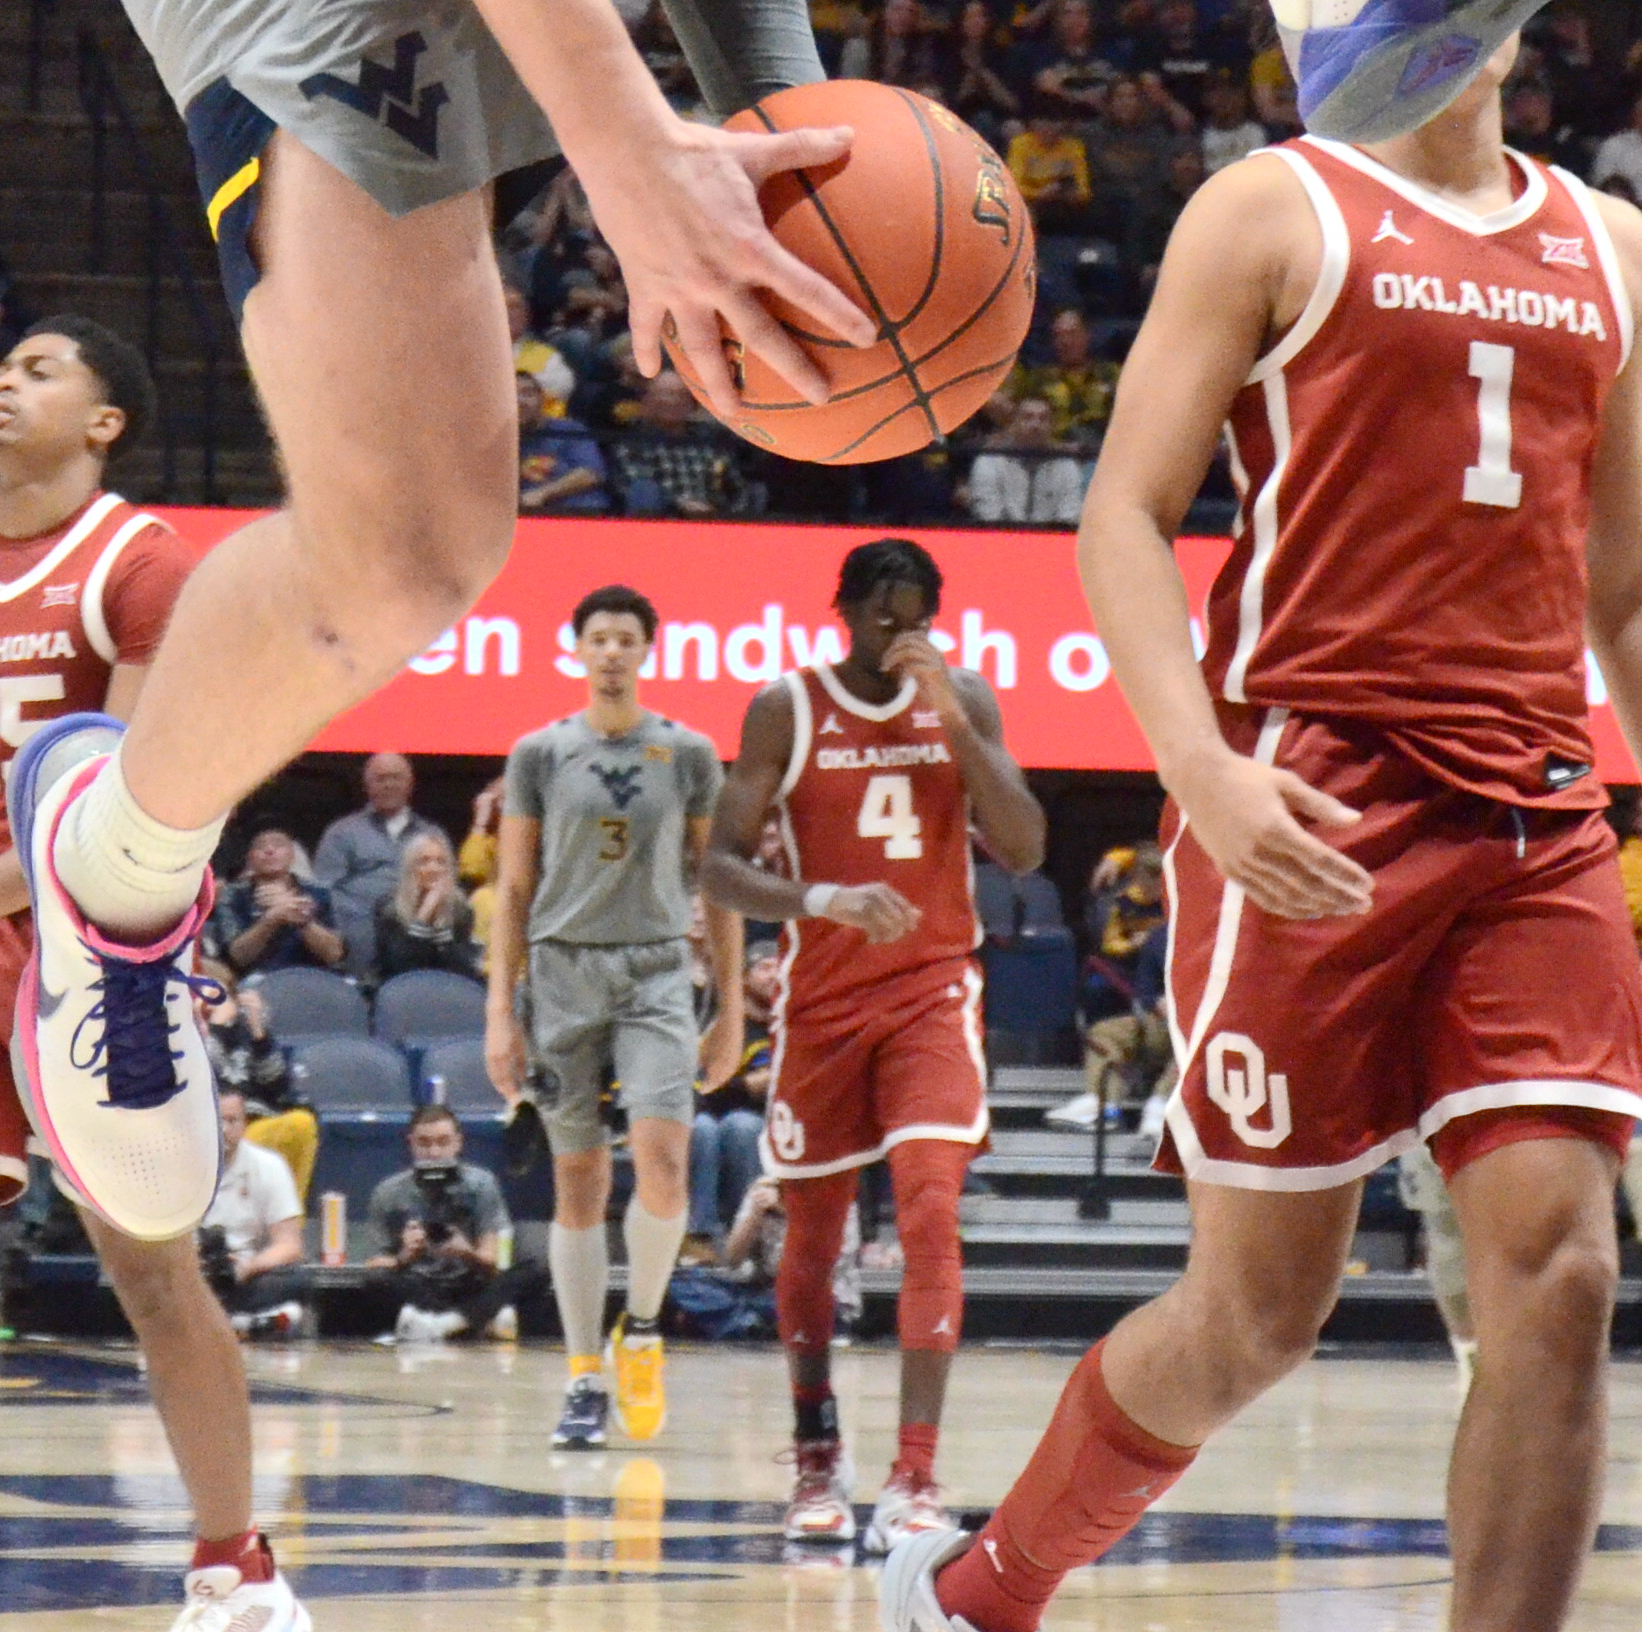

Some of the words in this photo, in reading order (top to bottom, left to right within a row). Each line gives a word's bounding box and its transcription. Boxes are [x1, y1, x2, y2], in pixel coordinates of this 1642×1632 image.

[1372, 272, 1607, 343] OKLAHOMA
[1462, 341, 1522, 509] 1
[816, 743, 952, 770] OKLAHOMA
[598, 816, 630, 862] 3
[857, 774, 923, 860] 4
[1205, 1031, 1293, 1149] OU
